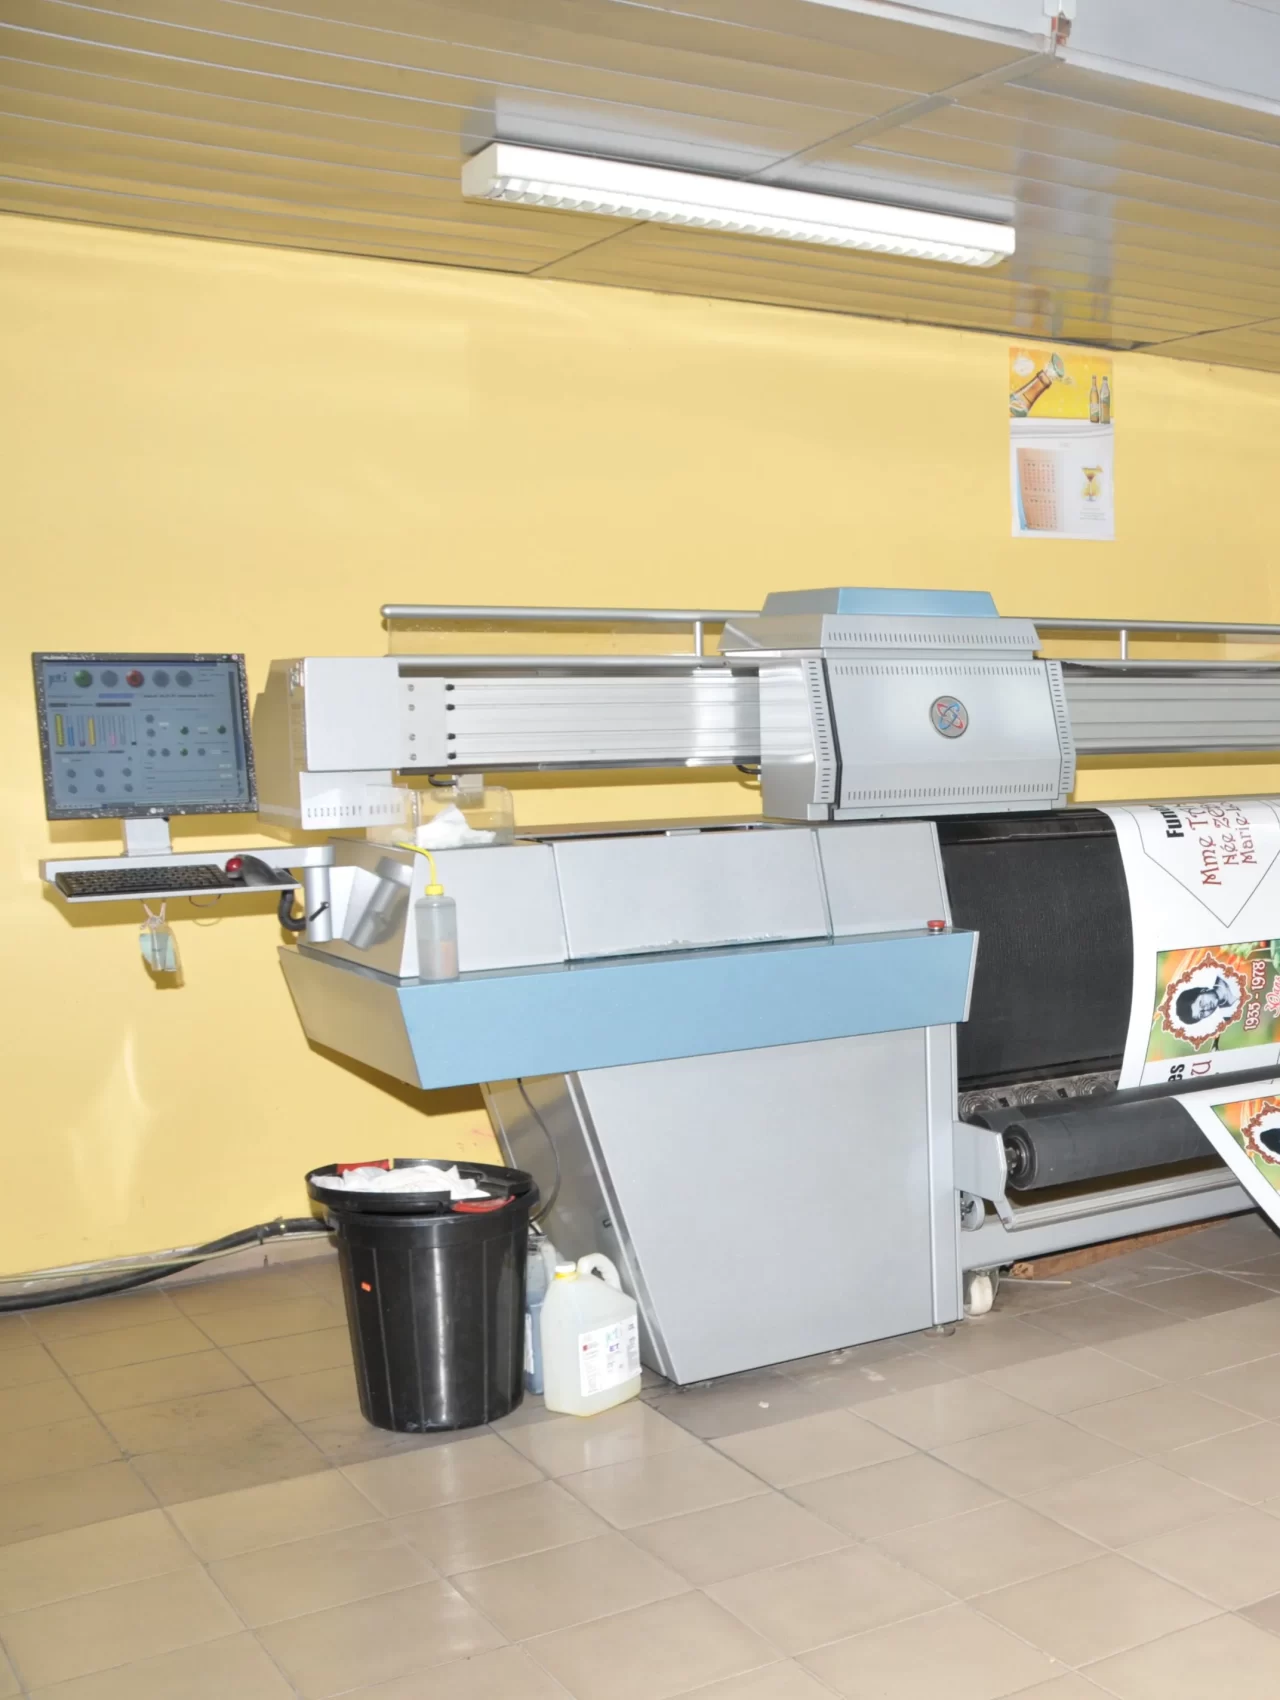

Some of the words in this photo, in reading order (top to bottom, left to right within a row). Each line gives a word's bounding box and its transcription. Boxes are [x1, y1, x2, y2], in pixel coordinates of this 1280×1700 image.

[1199, 836, 1222, 885] Mme
[1220, 833, 1239, 865] Née
[1244, 1002, 1260, 1031] 1935
[1252, 960, 1266, 990] 1978
